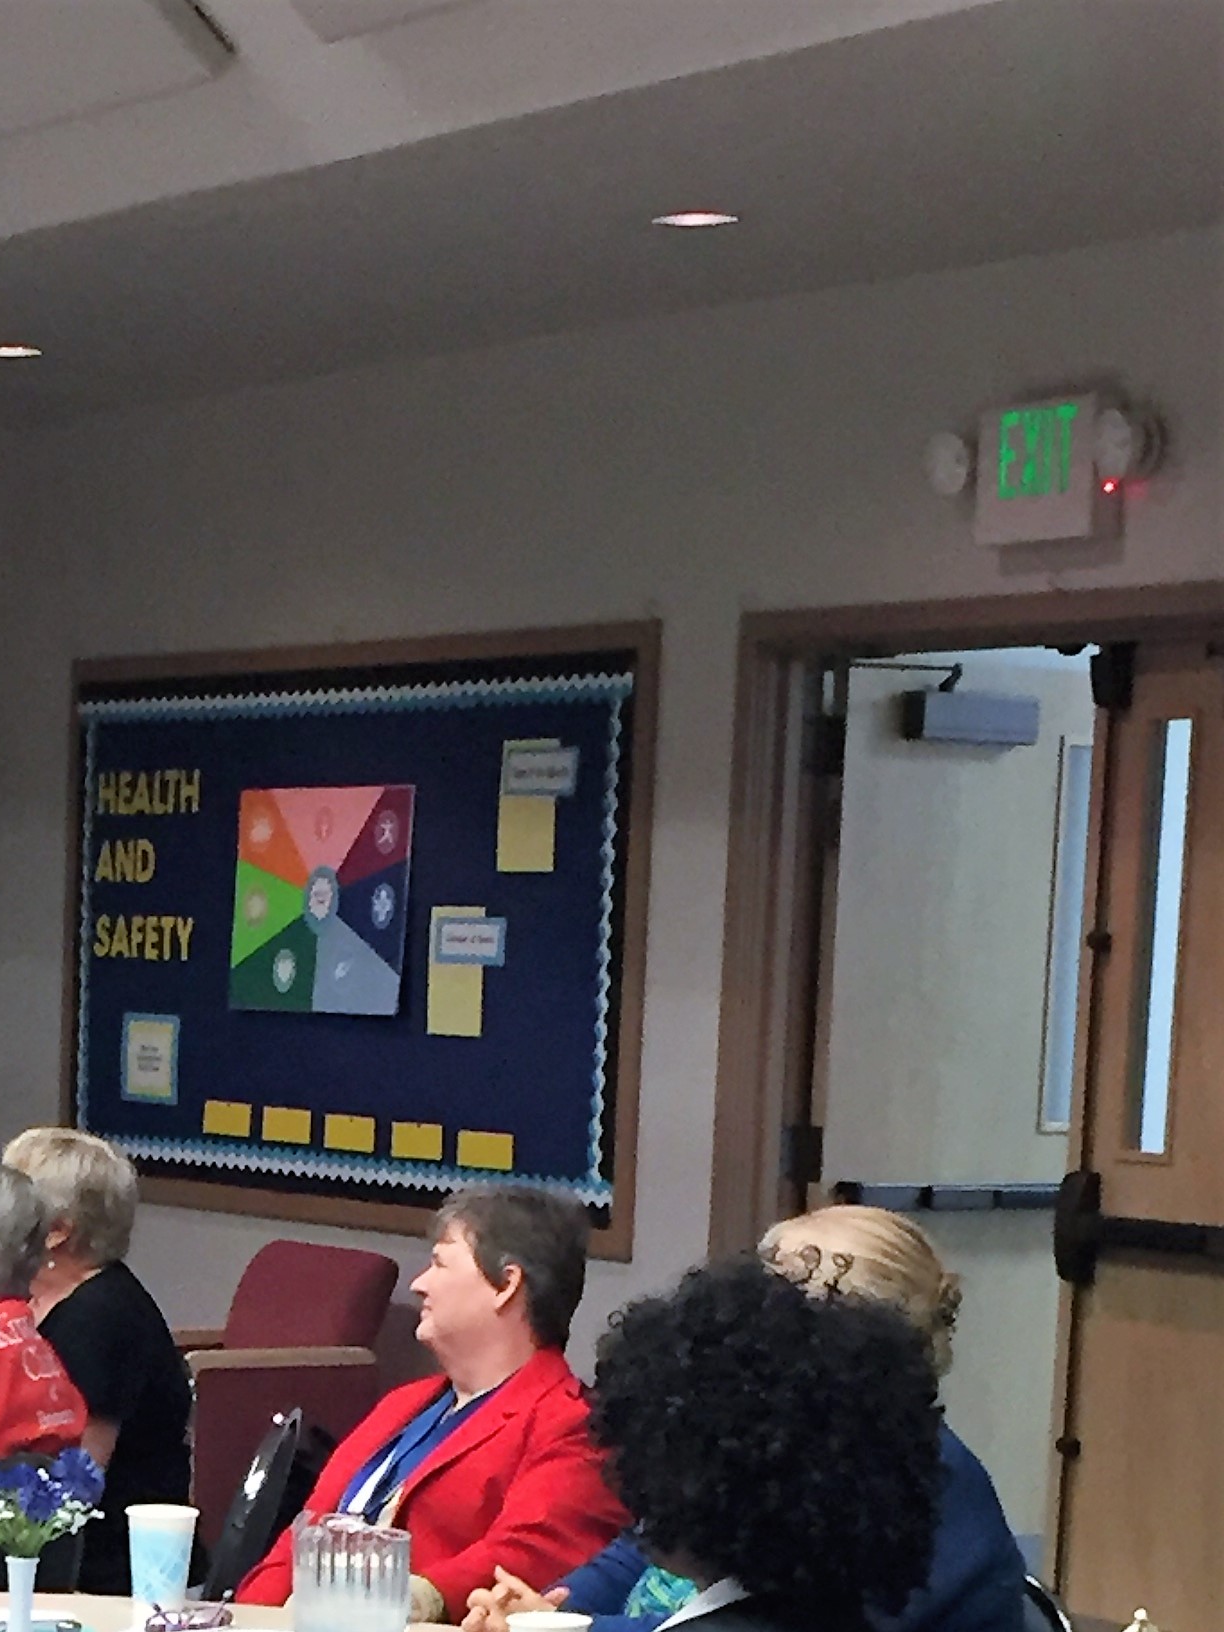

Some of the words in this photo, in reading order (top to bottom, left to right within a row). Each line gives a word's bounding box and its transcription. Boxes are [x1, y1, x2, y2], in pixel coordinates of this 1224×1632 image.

[998, 403, 1077, 498] EXIT
[97, 769, 201, 815] HEALTH
[94, 839, 156, 883] AND
[93, 913, 194, 961] SAFETY
